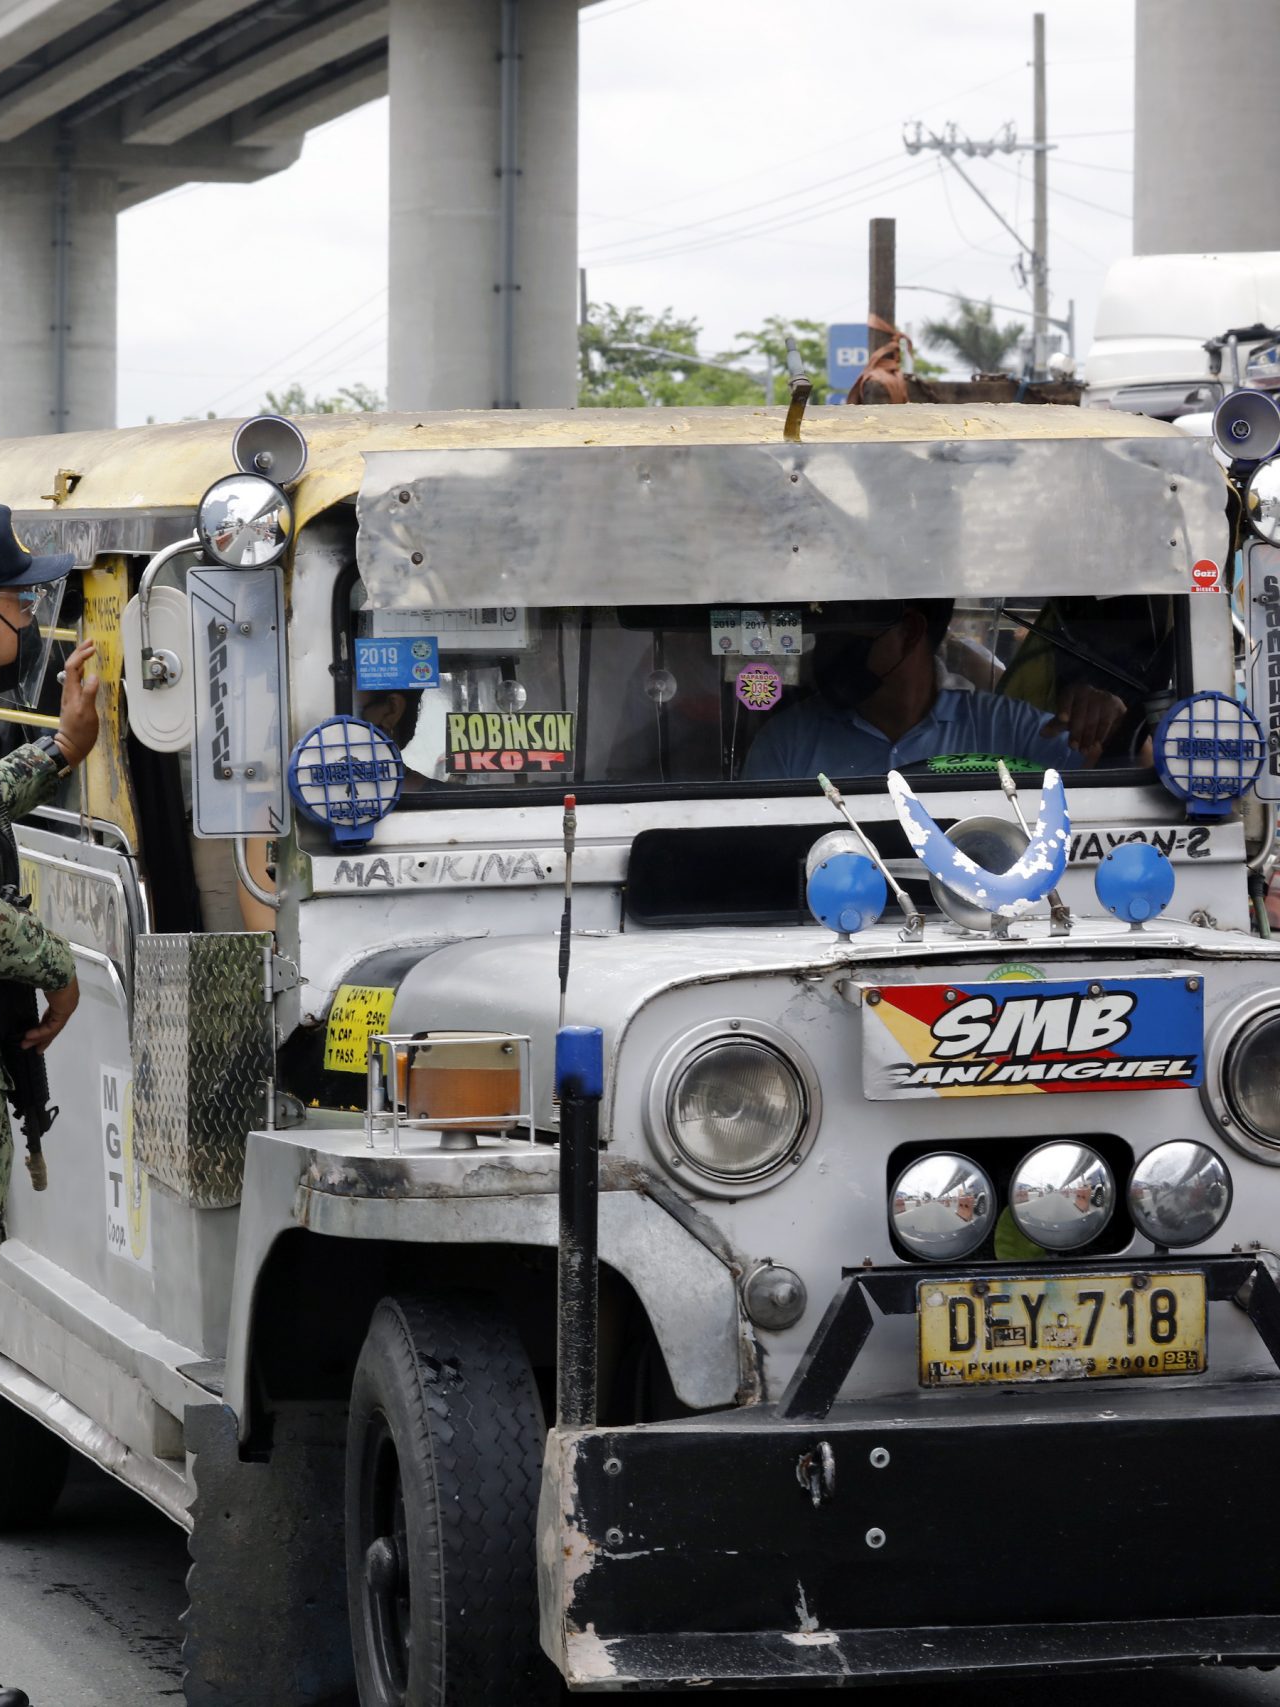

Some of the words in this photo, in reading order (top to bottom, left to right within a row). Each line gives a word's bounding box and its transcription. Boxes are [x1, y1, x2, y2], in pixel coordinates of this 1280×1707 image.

[837, 347, 869, 366] BD
[1193, 569, 1217, 578] Gazz
[745, 621, 767, 629] 2017
[360, 647, 398, 665] 2019
[751, 682, 768, 694] 036
[448, 713, 572, 752] ROBINSON
[454, 751, 565, 771] IKOT
[334, 852, 545, 888] MARIKINA
[932, 995, 1134, 1059] SMB
[883, 1066, 982, 1085] SAN
[991, 1060, 1194, 1081] MIGUEL
[1078, 1289, 1178, 1346] 718
[1107, 1355, 1159, 1369] 2000
[1165, 1352, 1187, 1364] 98
